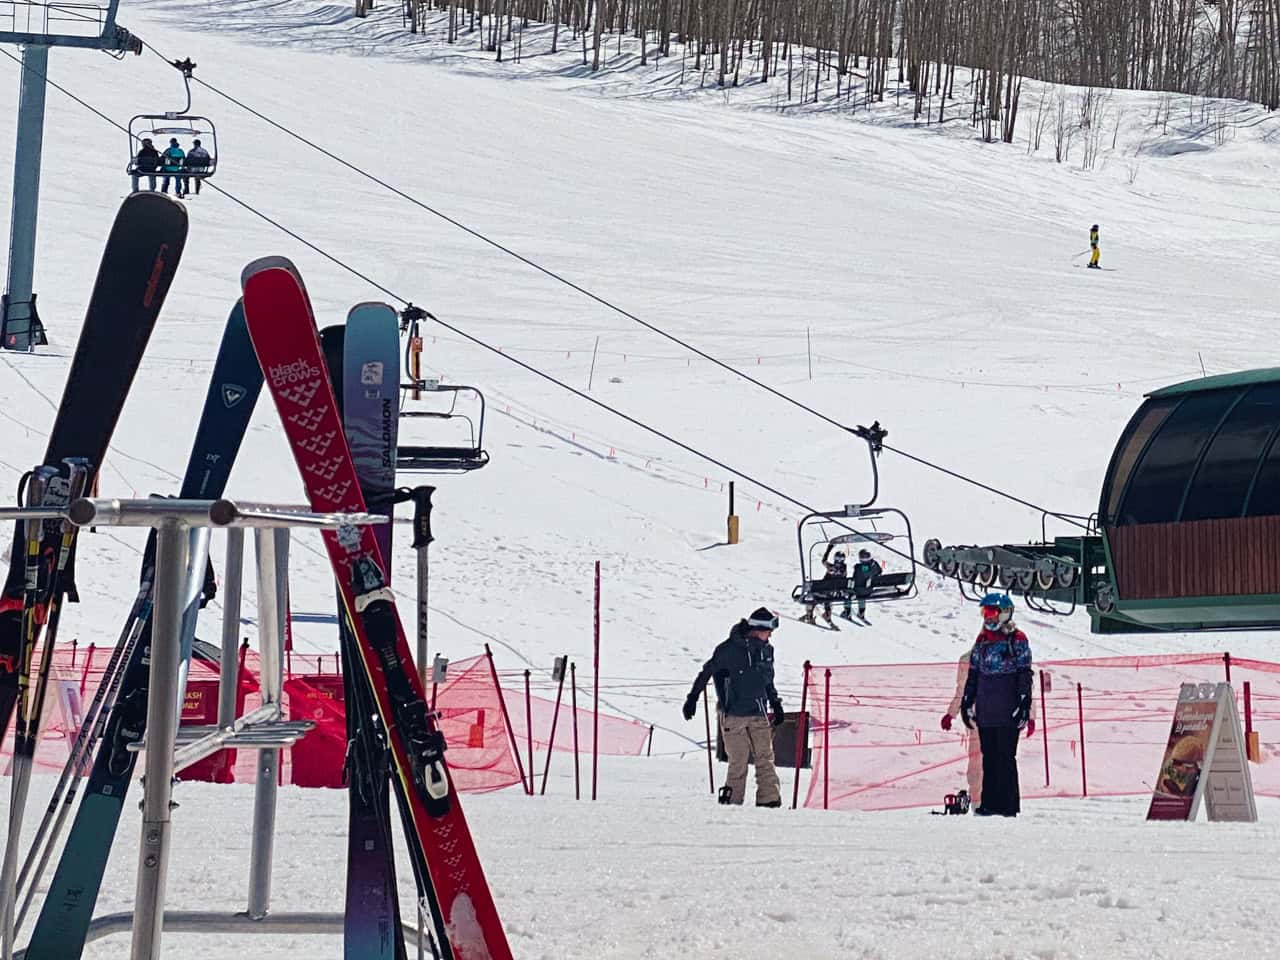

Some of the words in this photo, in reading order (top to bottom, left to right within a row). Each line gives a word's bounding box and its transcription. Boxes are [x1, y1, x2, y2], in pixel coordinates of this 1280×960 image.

[268, 357, 310, 379] black
[272, 366, 321, 387] crows
[383, 398, 391, 468] SALOMON
